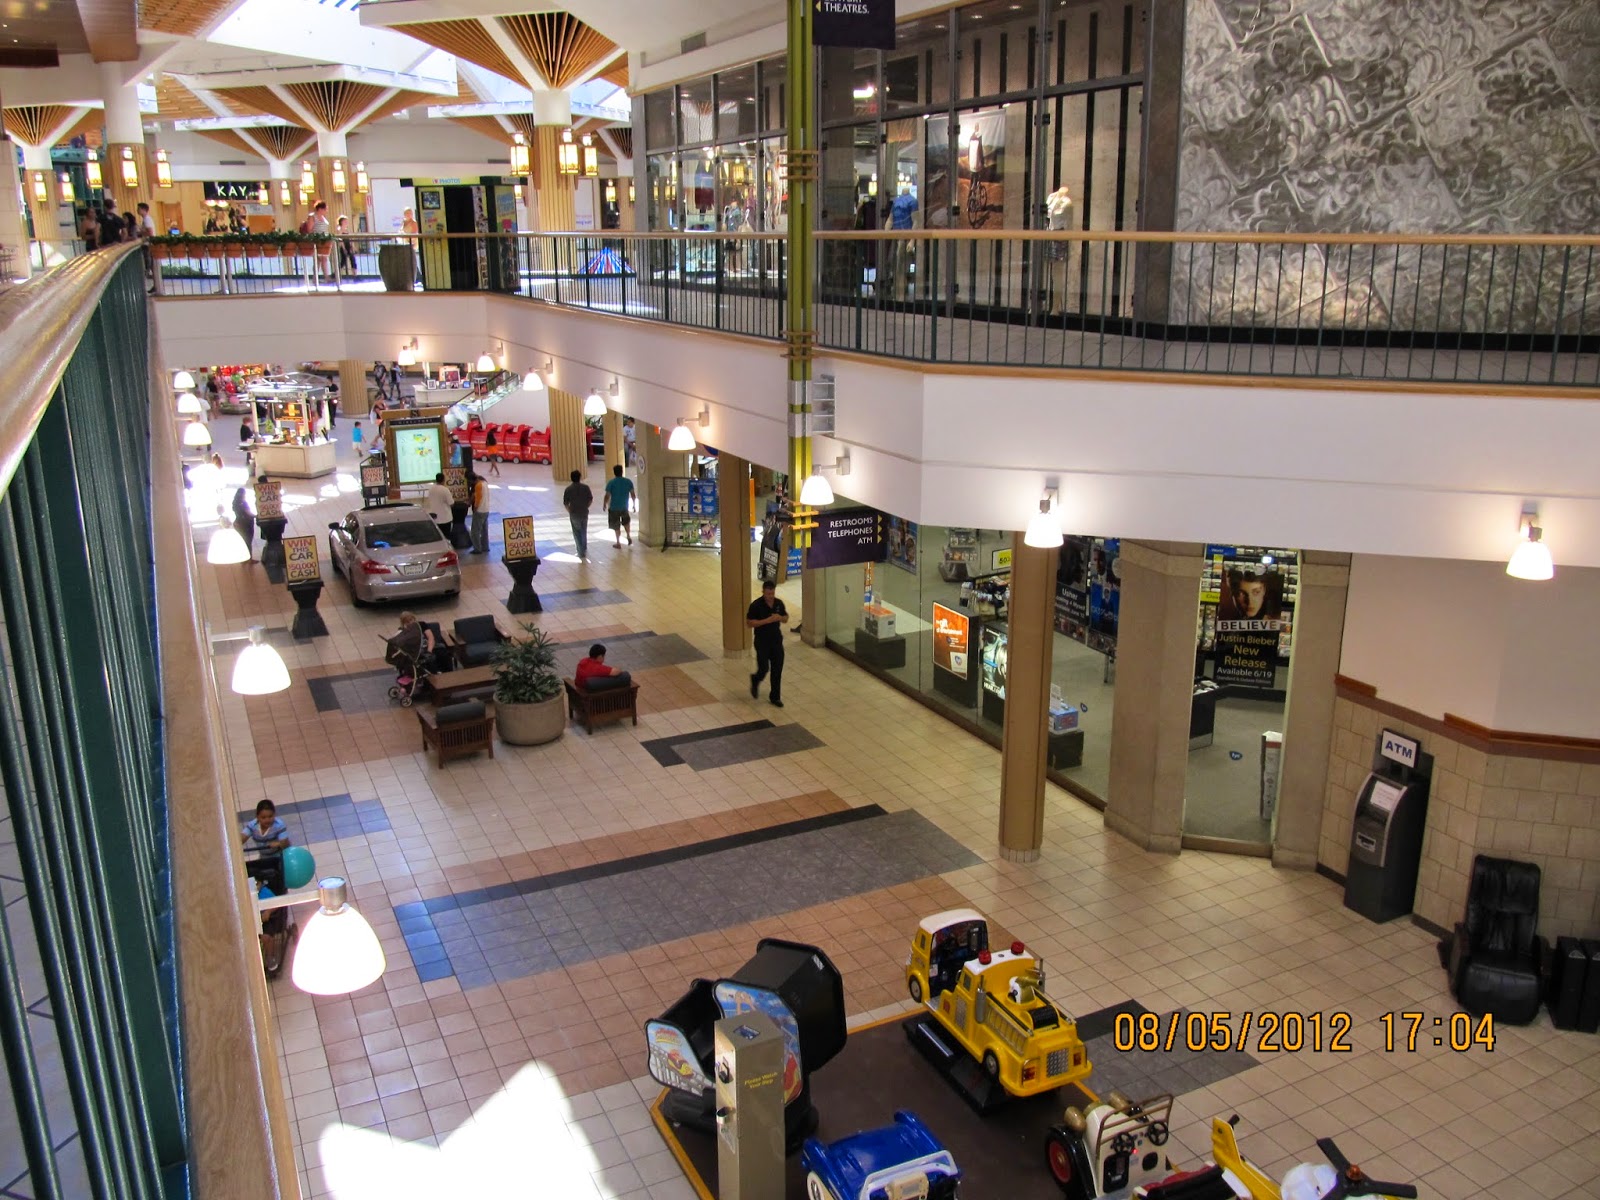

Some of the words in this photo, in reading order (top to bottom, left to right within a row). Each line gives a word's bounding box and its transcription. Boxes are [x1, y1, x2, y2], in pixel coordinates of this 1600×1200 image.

[217, 185, 247, 197] KAY
[445, 468, 465, 476] WIN
[507, 519, 530, 528] WIN
[830, 516, 873, 528] RESTROOMS
[508, 531, 531, 540] CAR
[828, 527, 873, 538] TELEPHONES
[287, 539, 312, 548] WIN
[857, 536, 873, 545] ATM
[289, 552, 314, 561] CAR
[508, 548, 533, 556] CASH
[288, 562, 316, 570] $50,000
[290, 569, 316, 578] CASH
[1061, 587, 1078, 601] Usher
[1220, 621, 1278, 631] BELIEVE
[1219, 633, 1246, 643] Justin
[1246, 635, 1277, 646] Bieber
[1233, 645, 1260, 656] New
[1224, 656, 1268, 669] Release
[1217, 666, 1253, 677] Available
[1253, 670, 1273, 679] 6/19
[1385, 741, 1413, 759] ATM
[744, 1077, 762, 1086] Please
[761, 1071, 778, 1080] Watch
